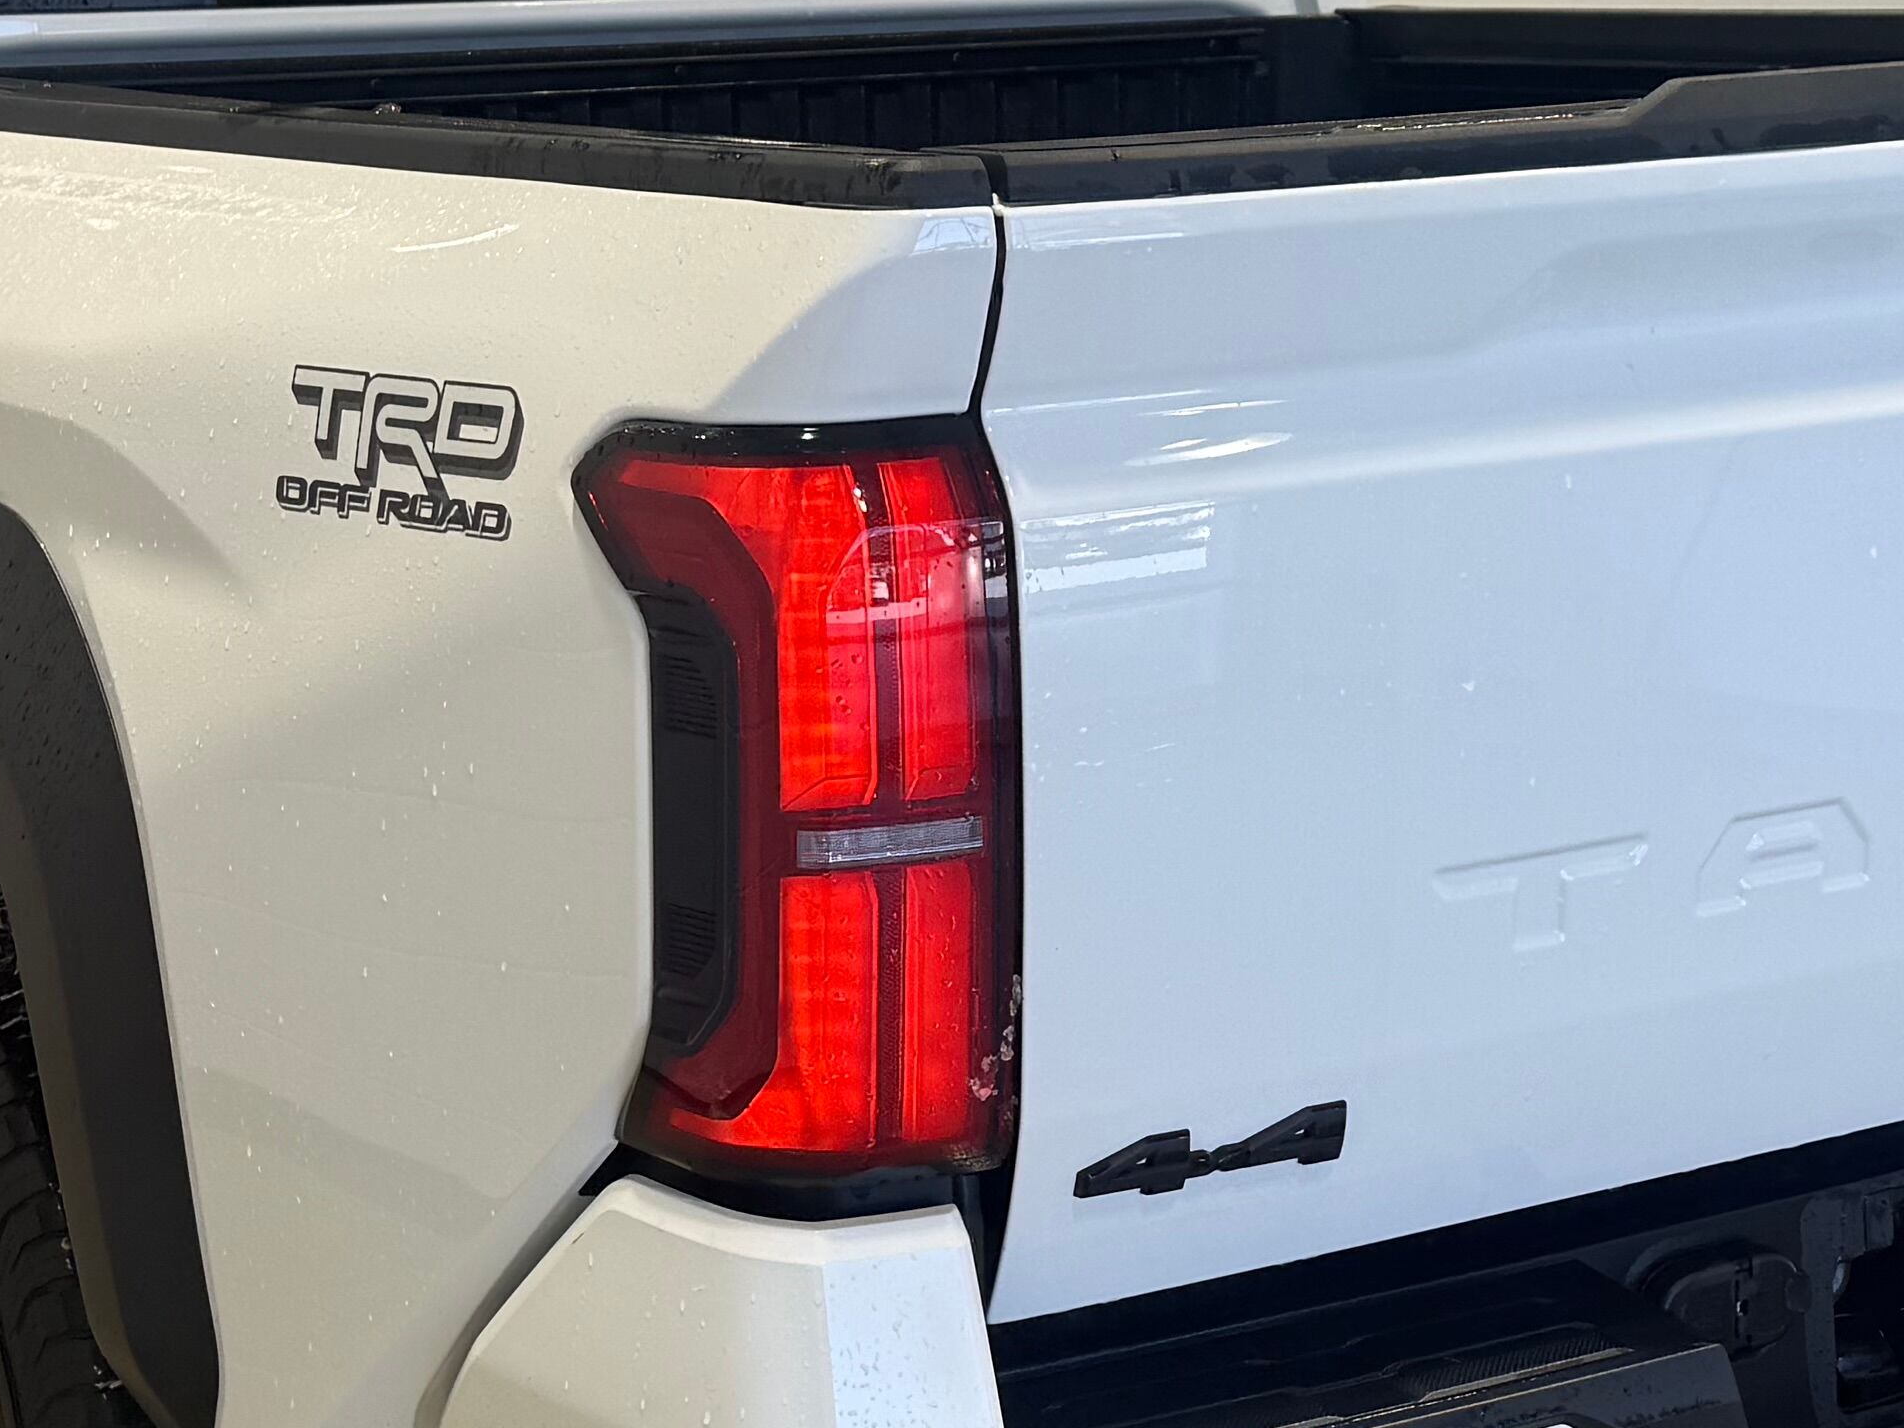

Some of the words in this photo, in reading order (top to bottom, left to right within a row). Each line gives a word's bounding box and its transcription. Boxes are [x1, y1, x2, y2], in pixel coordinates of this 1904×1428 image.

[291, 364, 525, 498] TRD
[276, 474, 371, 520] OFF
[376, 488, 512, 542] ROAD
